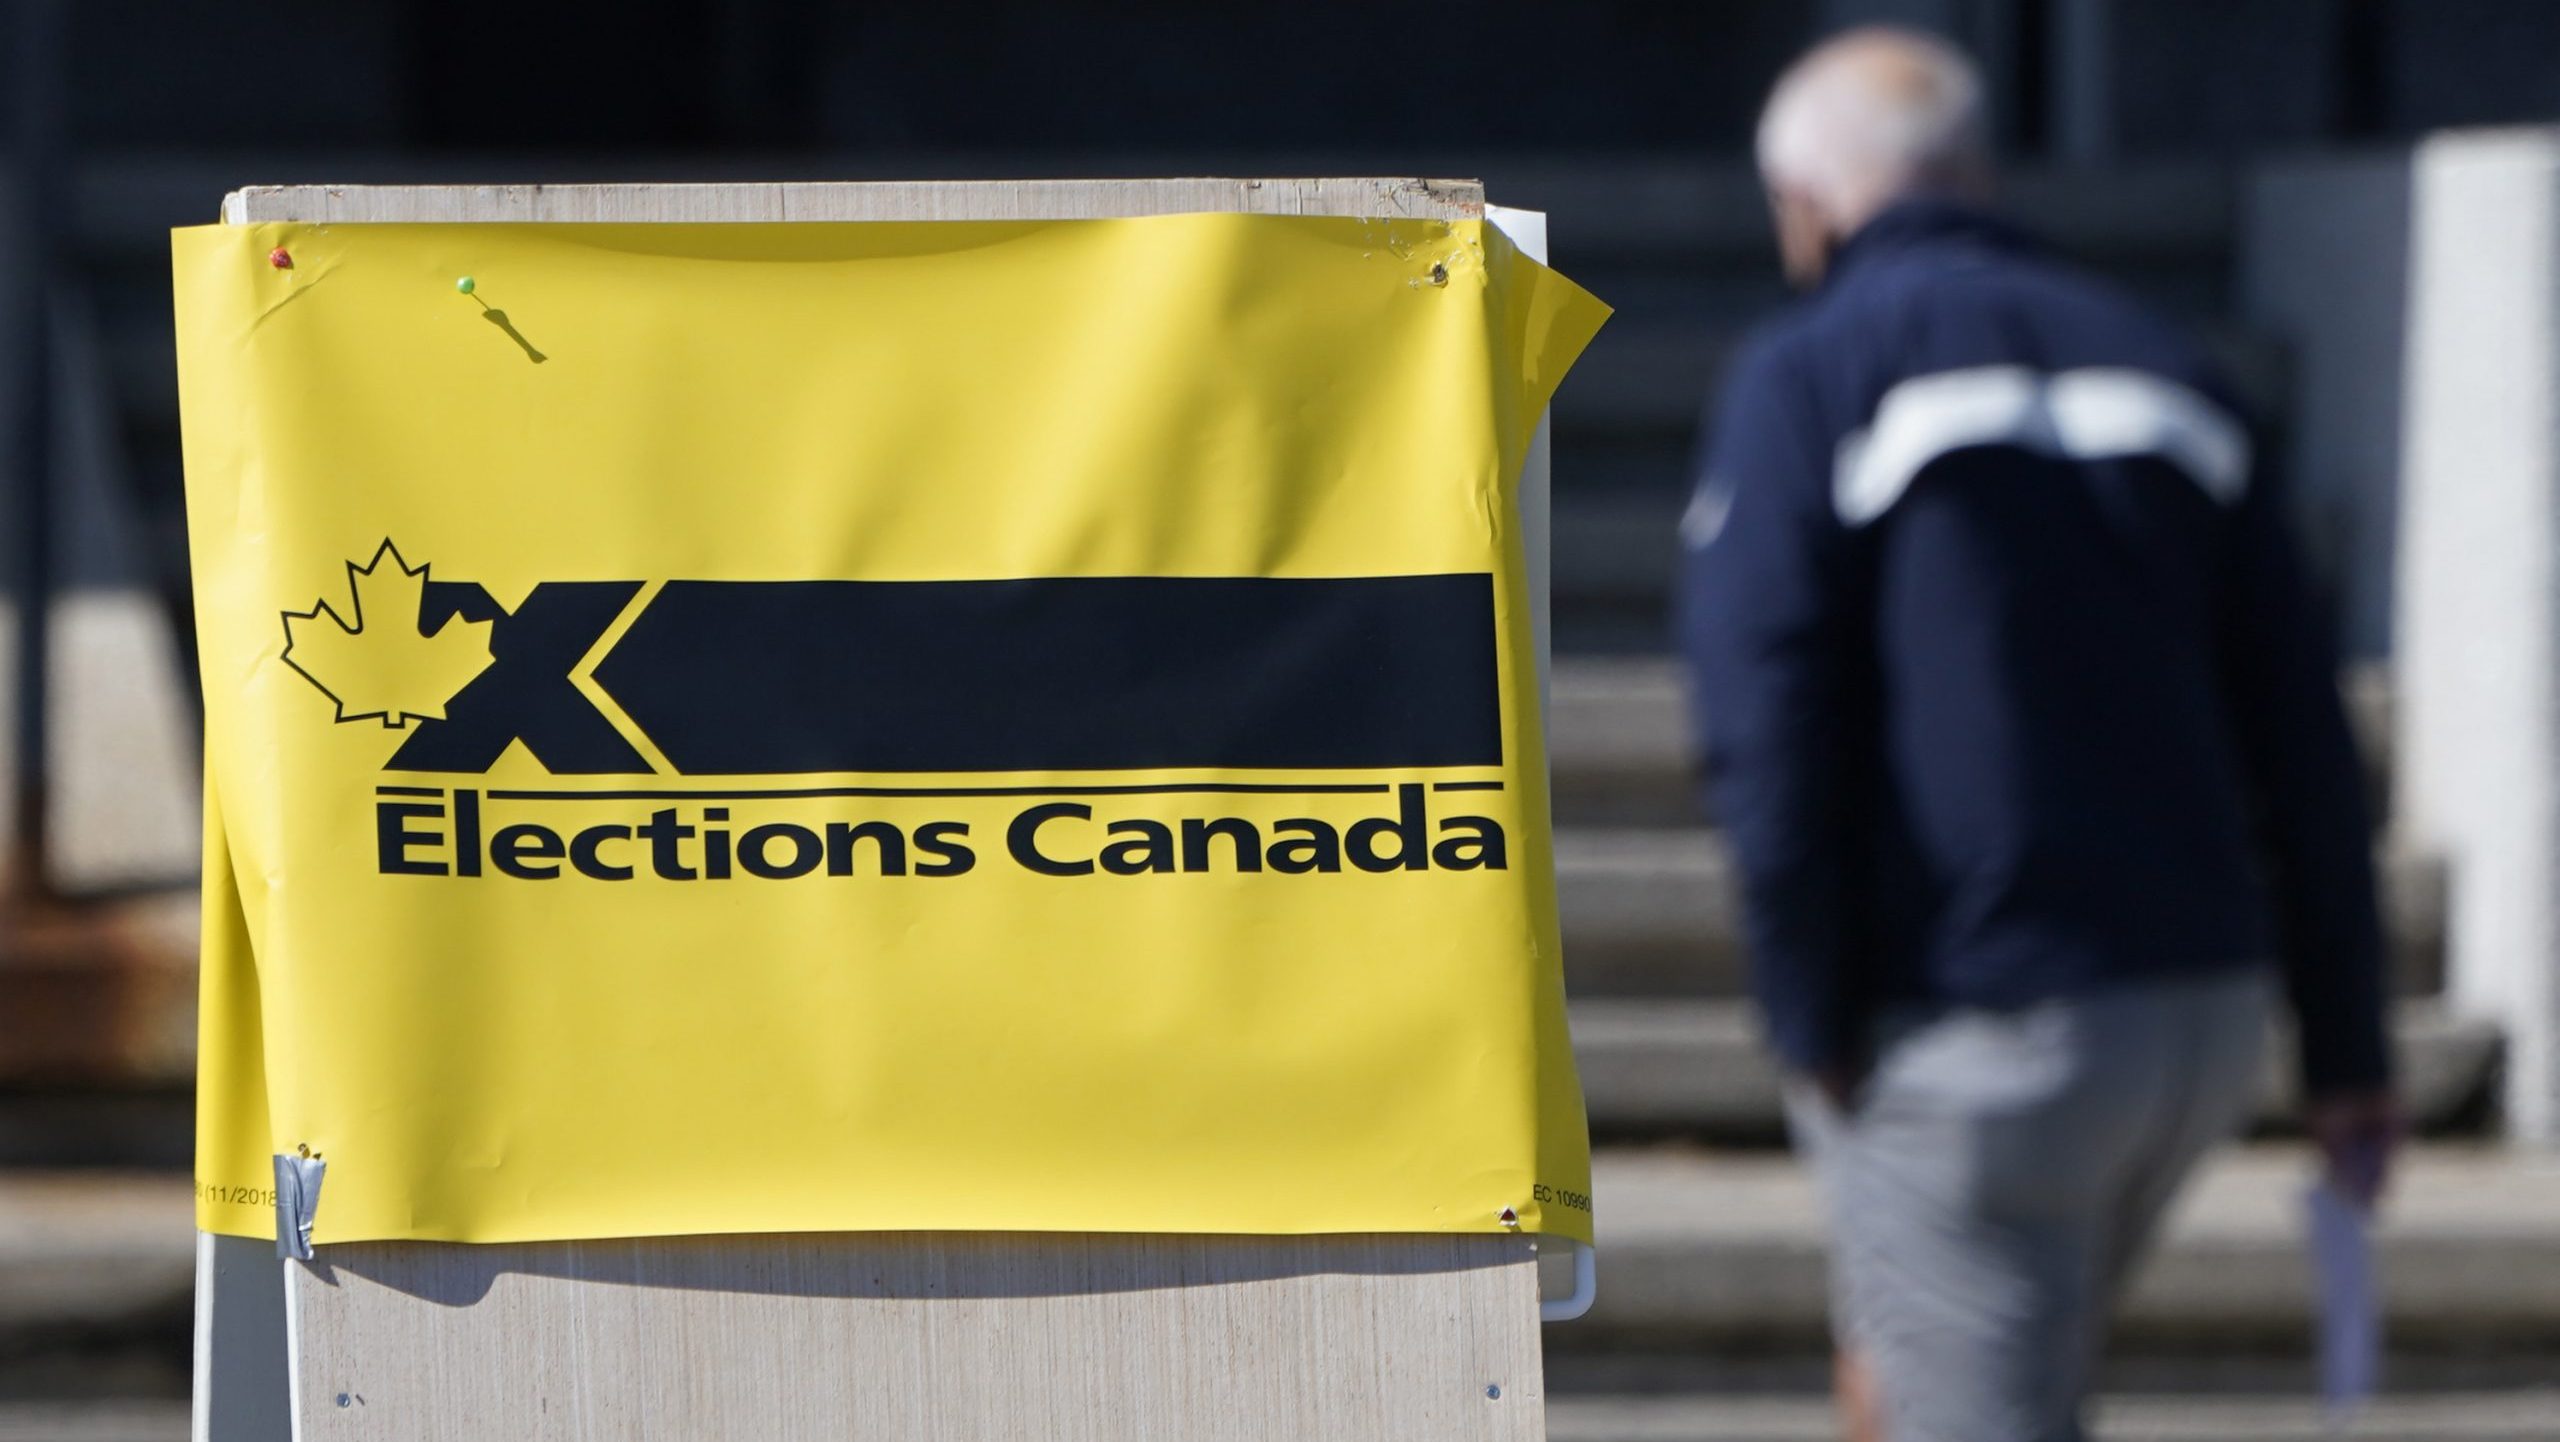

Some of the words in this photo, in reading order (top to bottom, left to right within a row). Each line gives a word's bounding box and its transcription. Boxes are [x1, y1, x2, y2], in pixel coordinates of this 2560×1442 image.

[376, 789, 975, 881] Elections
[1006, 783, 1508, 877] Canada
[1533, 1184, 1552, 1203] EC
